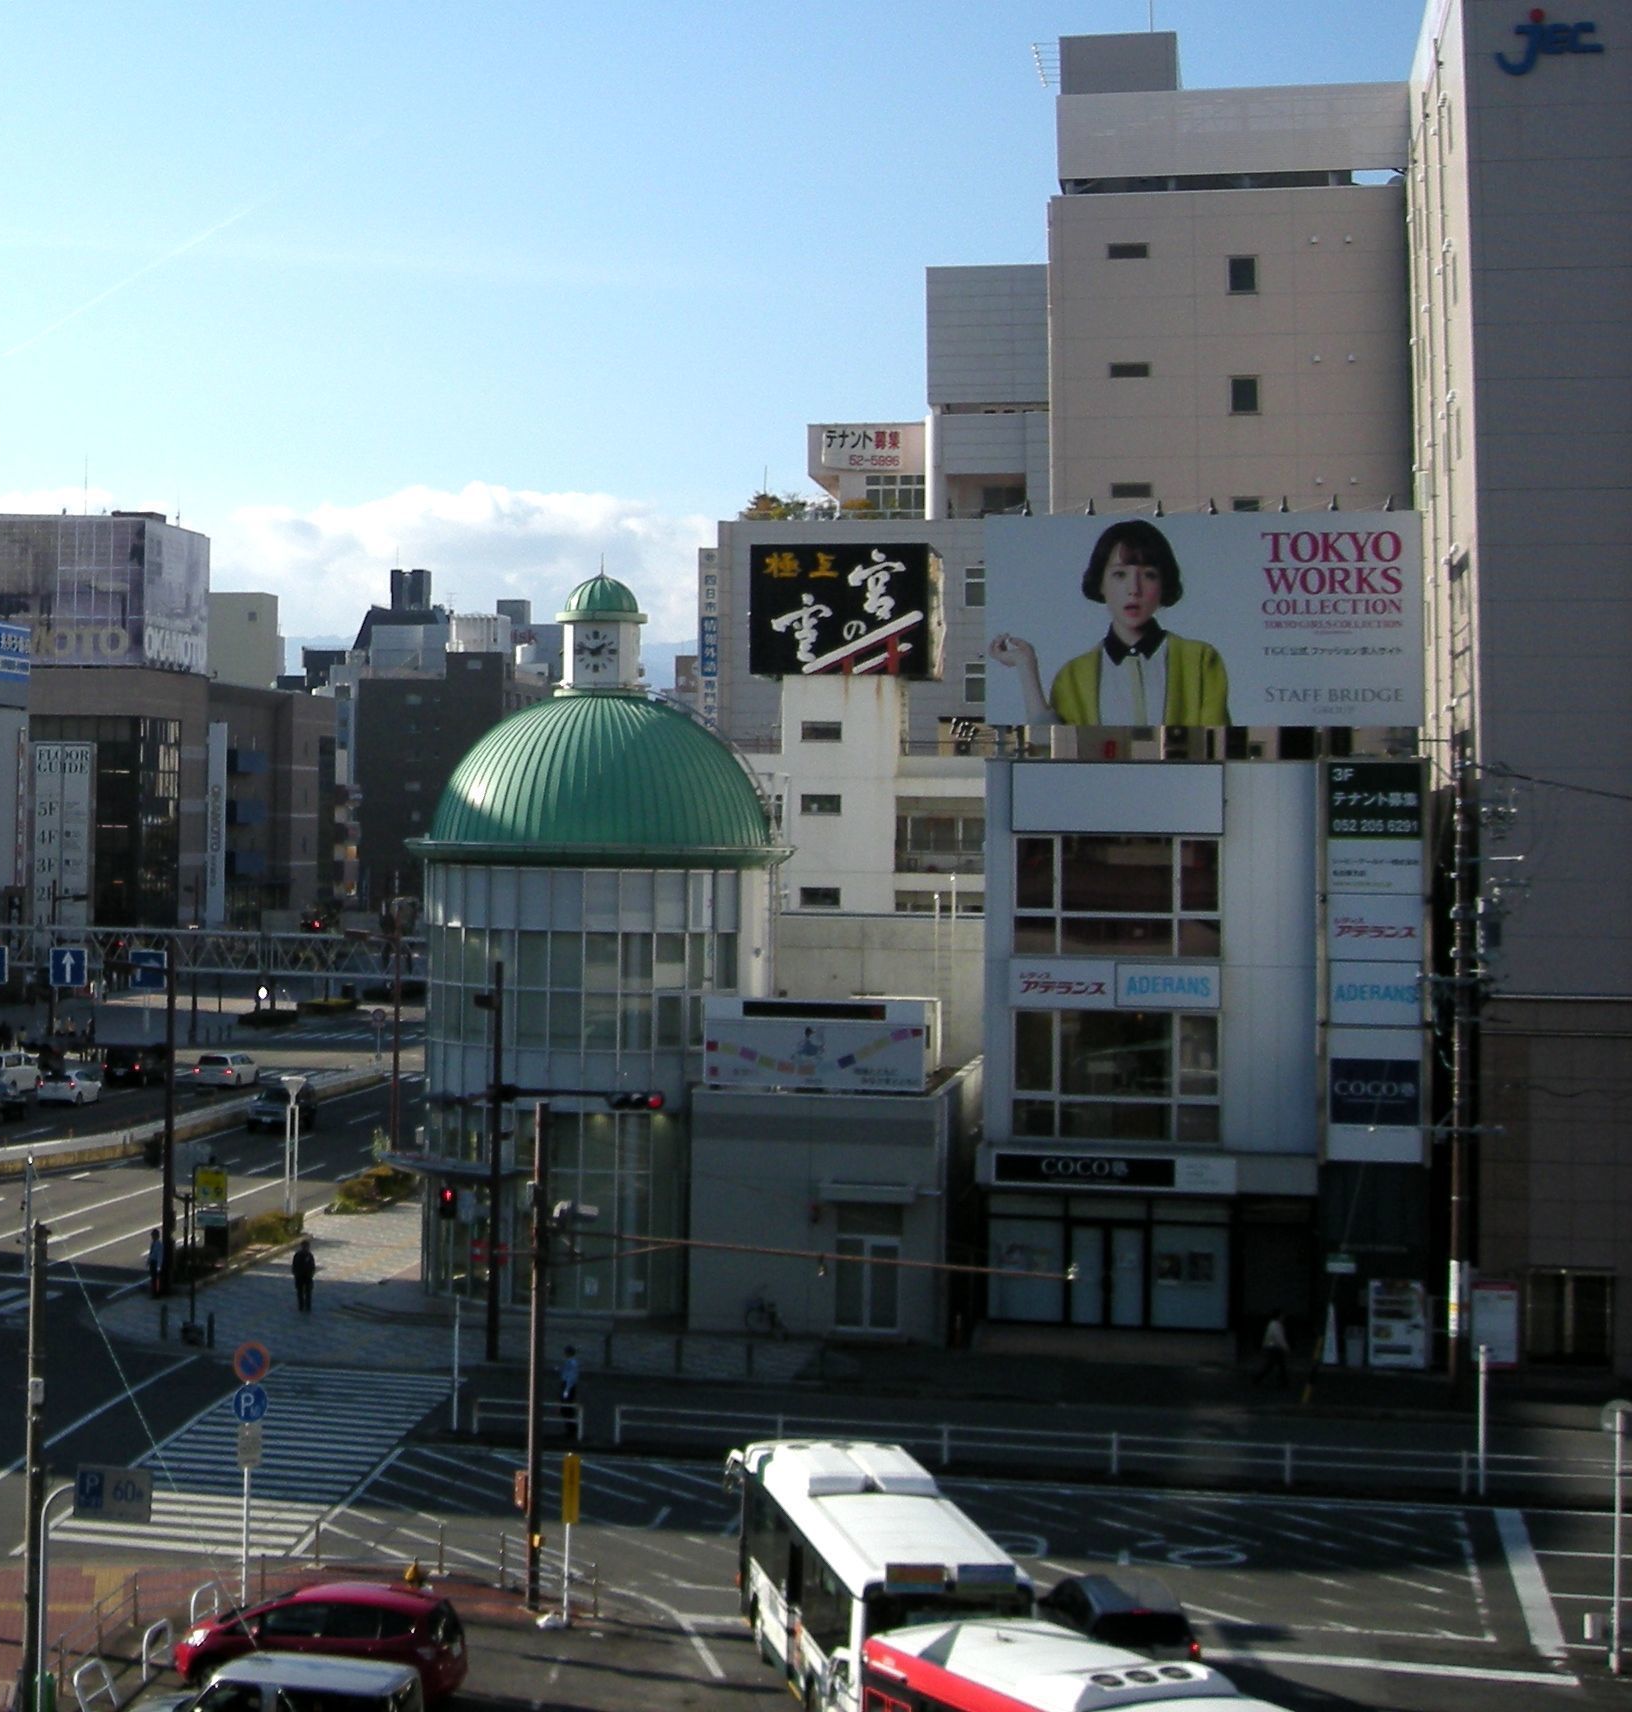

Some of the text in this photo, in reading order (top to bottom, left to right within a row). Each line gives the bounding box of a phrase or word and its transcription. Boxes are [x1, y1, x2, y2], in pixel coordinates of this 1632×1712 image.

[826, 430, 900, 450] テナント募集
[1261, 530, 1402, 563] TOKYO
[763, 552, 839, 578] 極上
[1263, 566, 1403, 595] WORKS
[1262, 598, 1403, 616] COLLECTION
[1328, 687, 1405, 703] BRIDGE
[38, 749, 89, 762] FLOOR
[38, 762, 88, 774] GUIDE
[1332, 768, 1354, 782] 3F
[1332, 791, 1418, 807] テナント募集
[1126, 975, 1211, 997] ADERANS
[1333, 983, 1418, 1004] ADERANS
